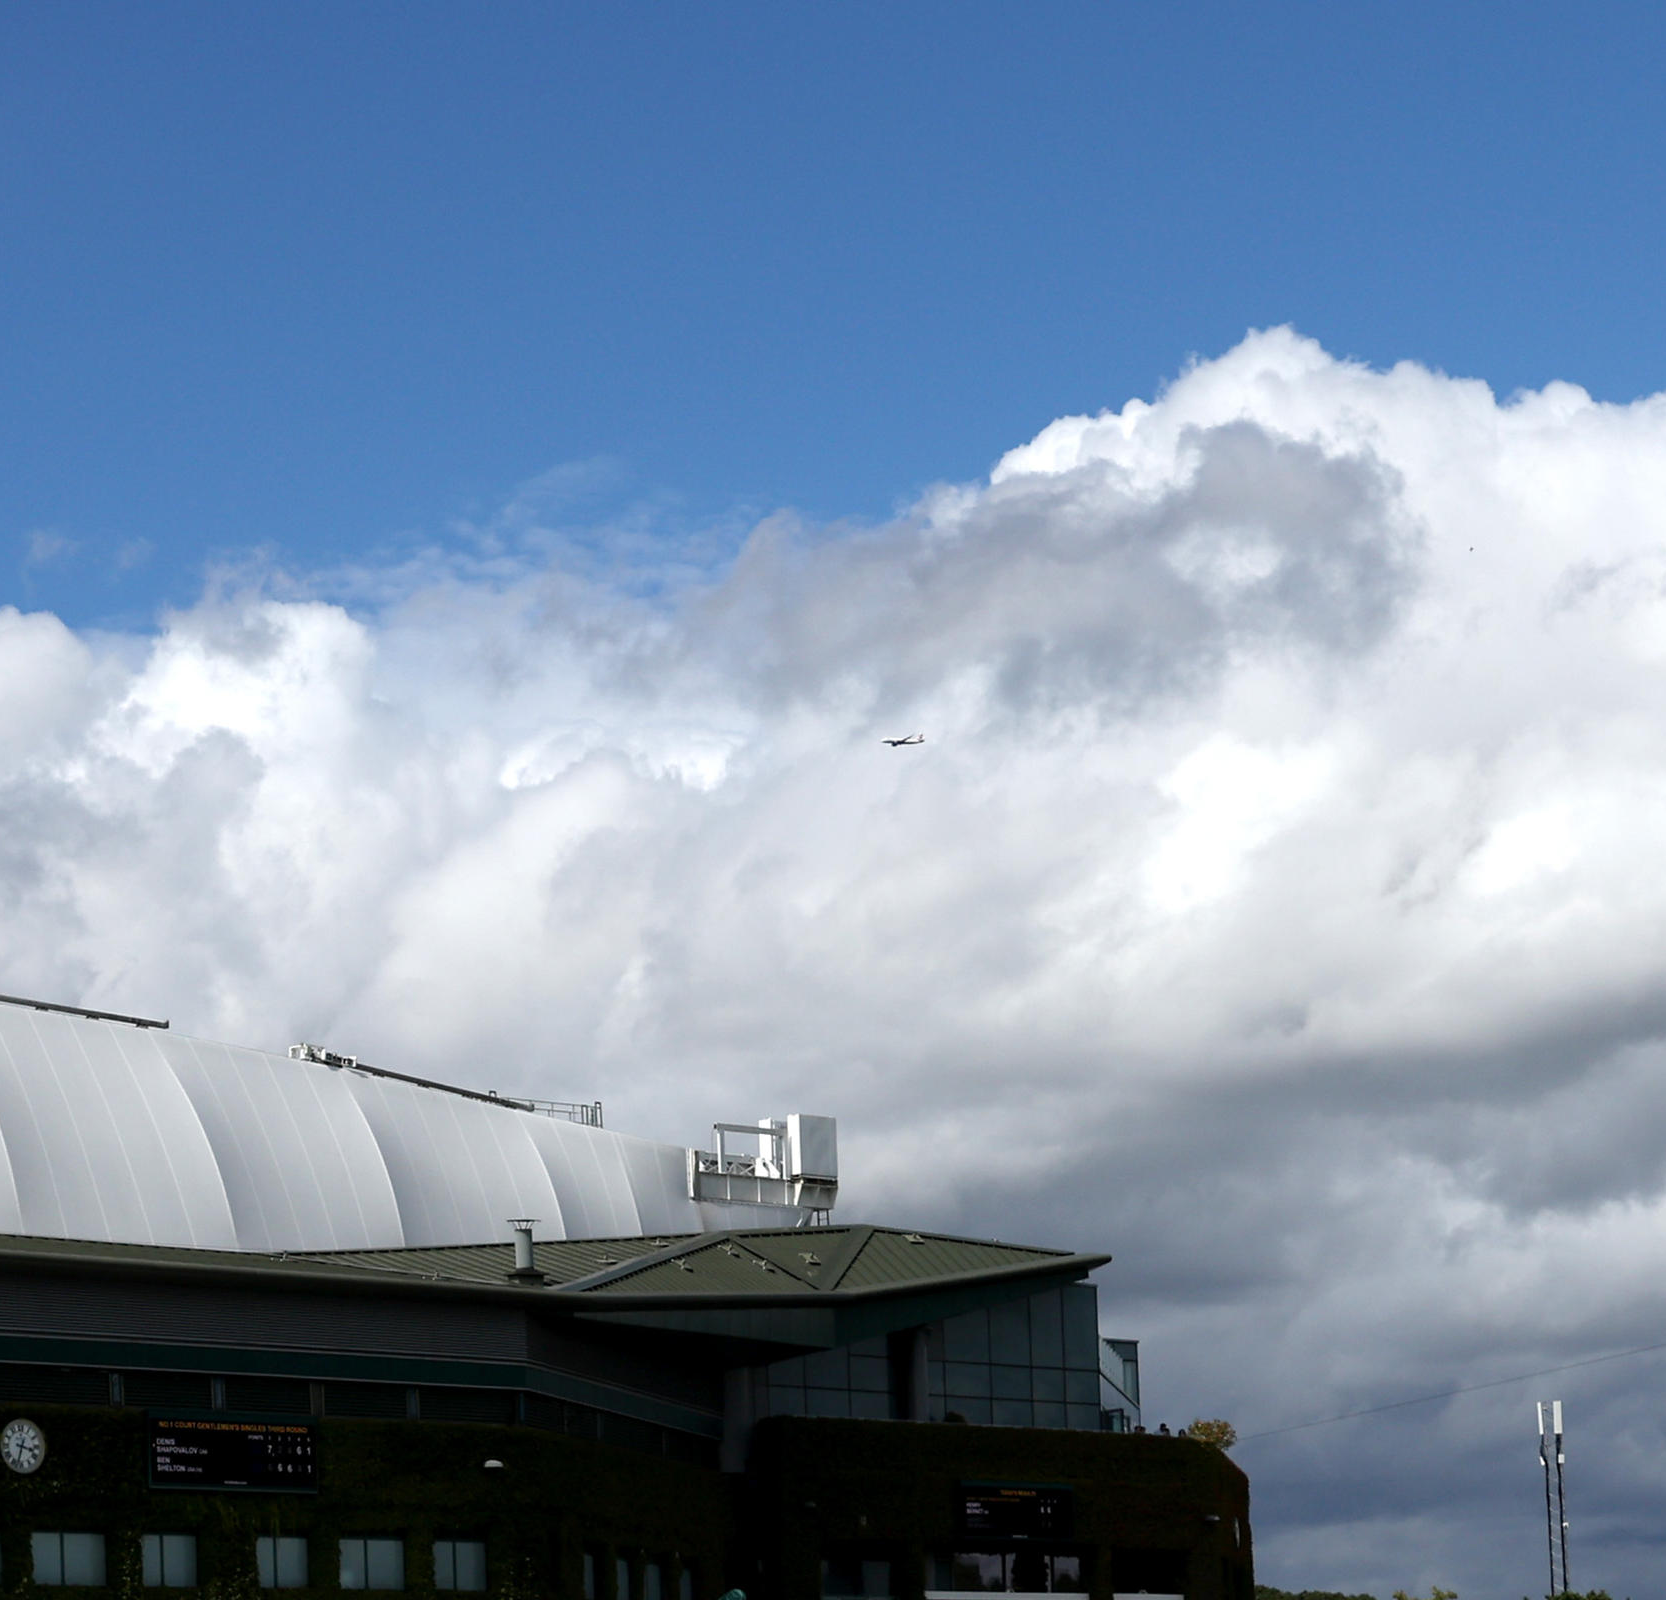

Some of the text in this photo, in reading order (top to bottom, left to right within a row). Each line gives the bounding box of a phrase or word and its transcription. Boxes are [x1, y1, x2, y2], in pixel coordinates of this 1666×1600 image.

[174, 1421, 196, 1429] COURT
[156, 1437, 176, 1445] DENIS
[156, 1446, 198, 1455] SHAPOVALOV
[307, 1446, 312, 1456] 1
[156, 1456, 171, 1464] BEN
[157, 1464, 186, 1473] SHELTON
[307, 1464, 312, 1474] 1
